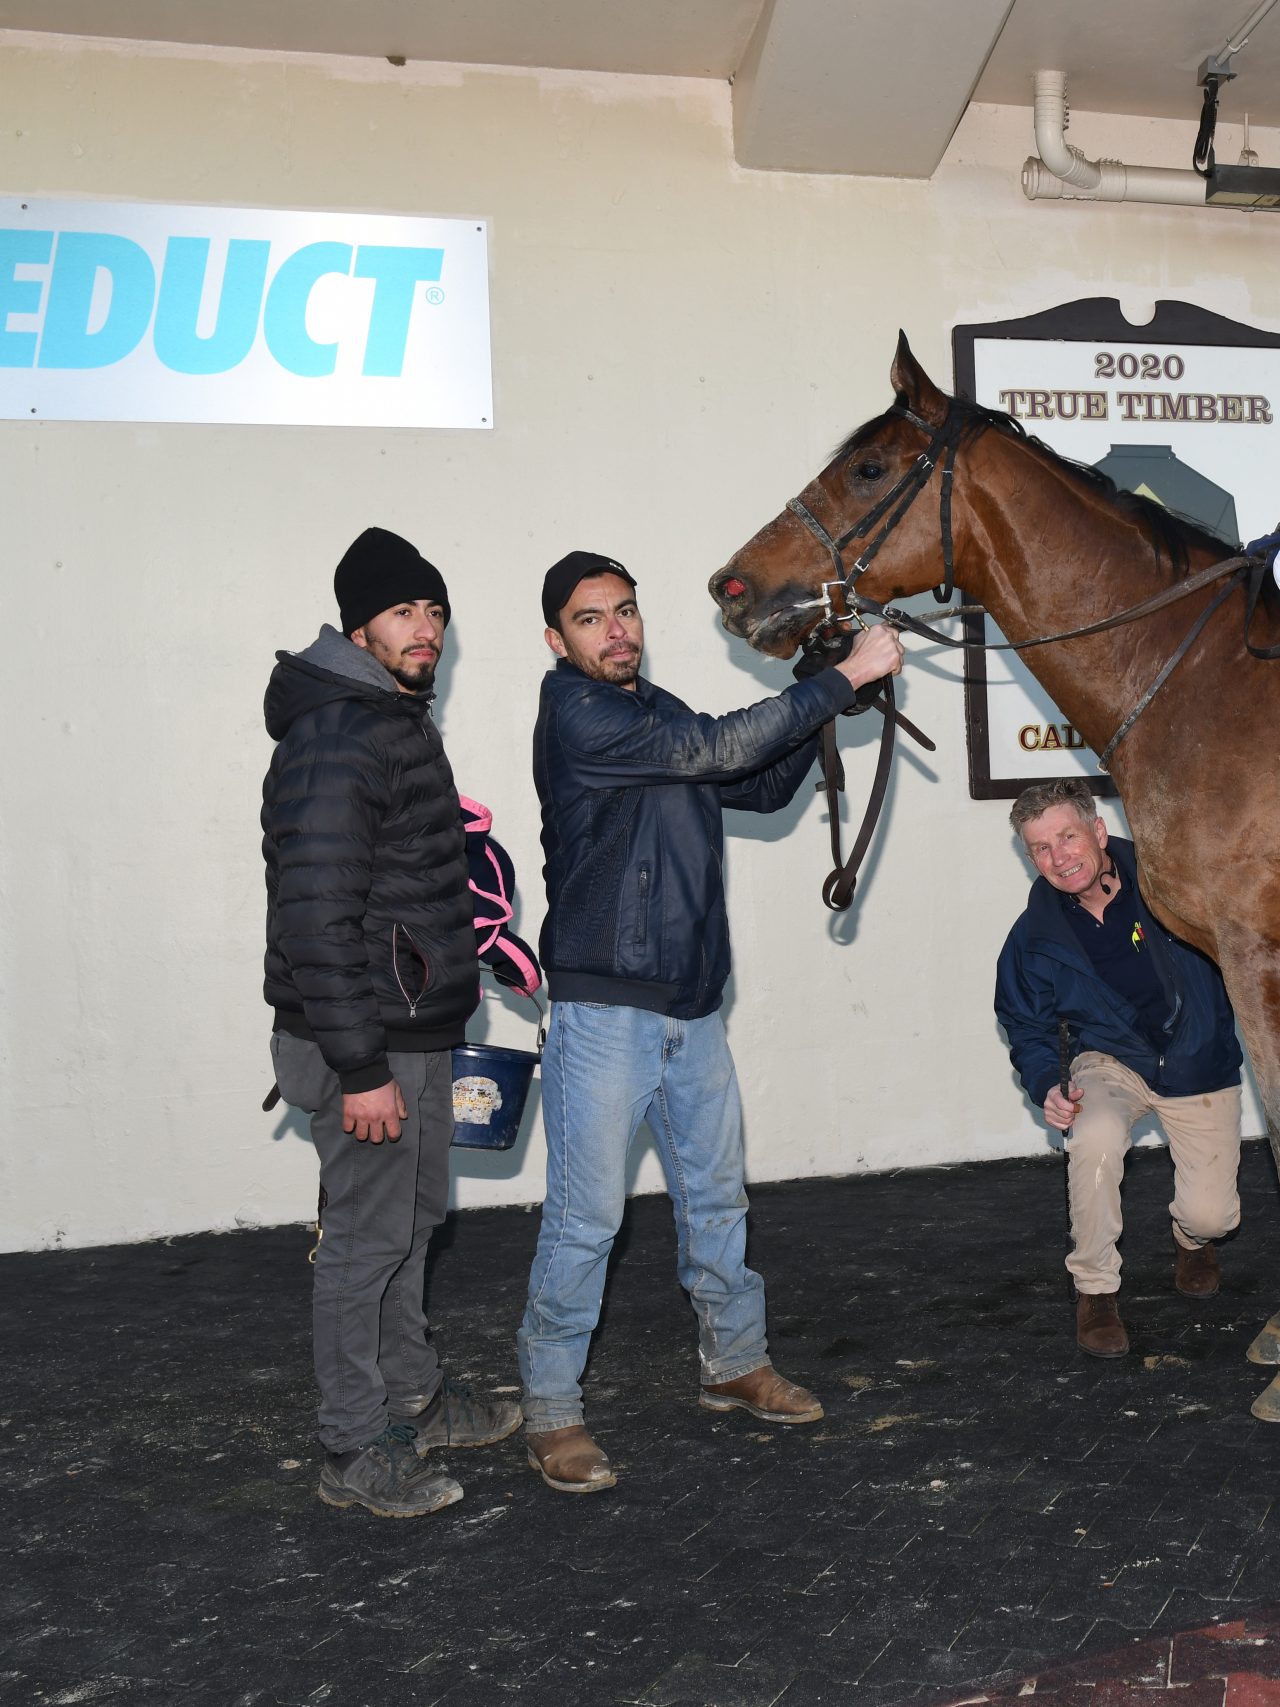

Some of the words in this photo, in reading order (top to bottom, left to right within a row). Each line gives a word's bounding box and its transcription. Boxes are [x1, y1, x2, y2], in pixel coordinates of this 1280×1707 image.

[1094, 352, 1185, 381] 2020
[999, 389, 1109, 421] TRUE
[1116, 391, 1274, 424] TIMBER
[1018, 724, 1086, 751] CAL
